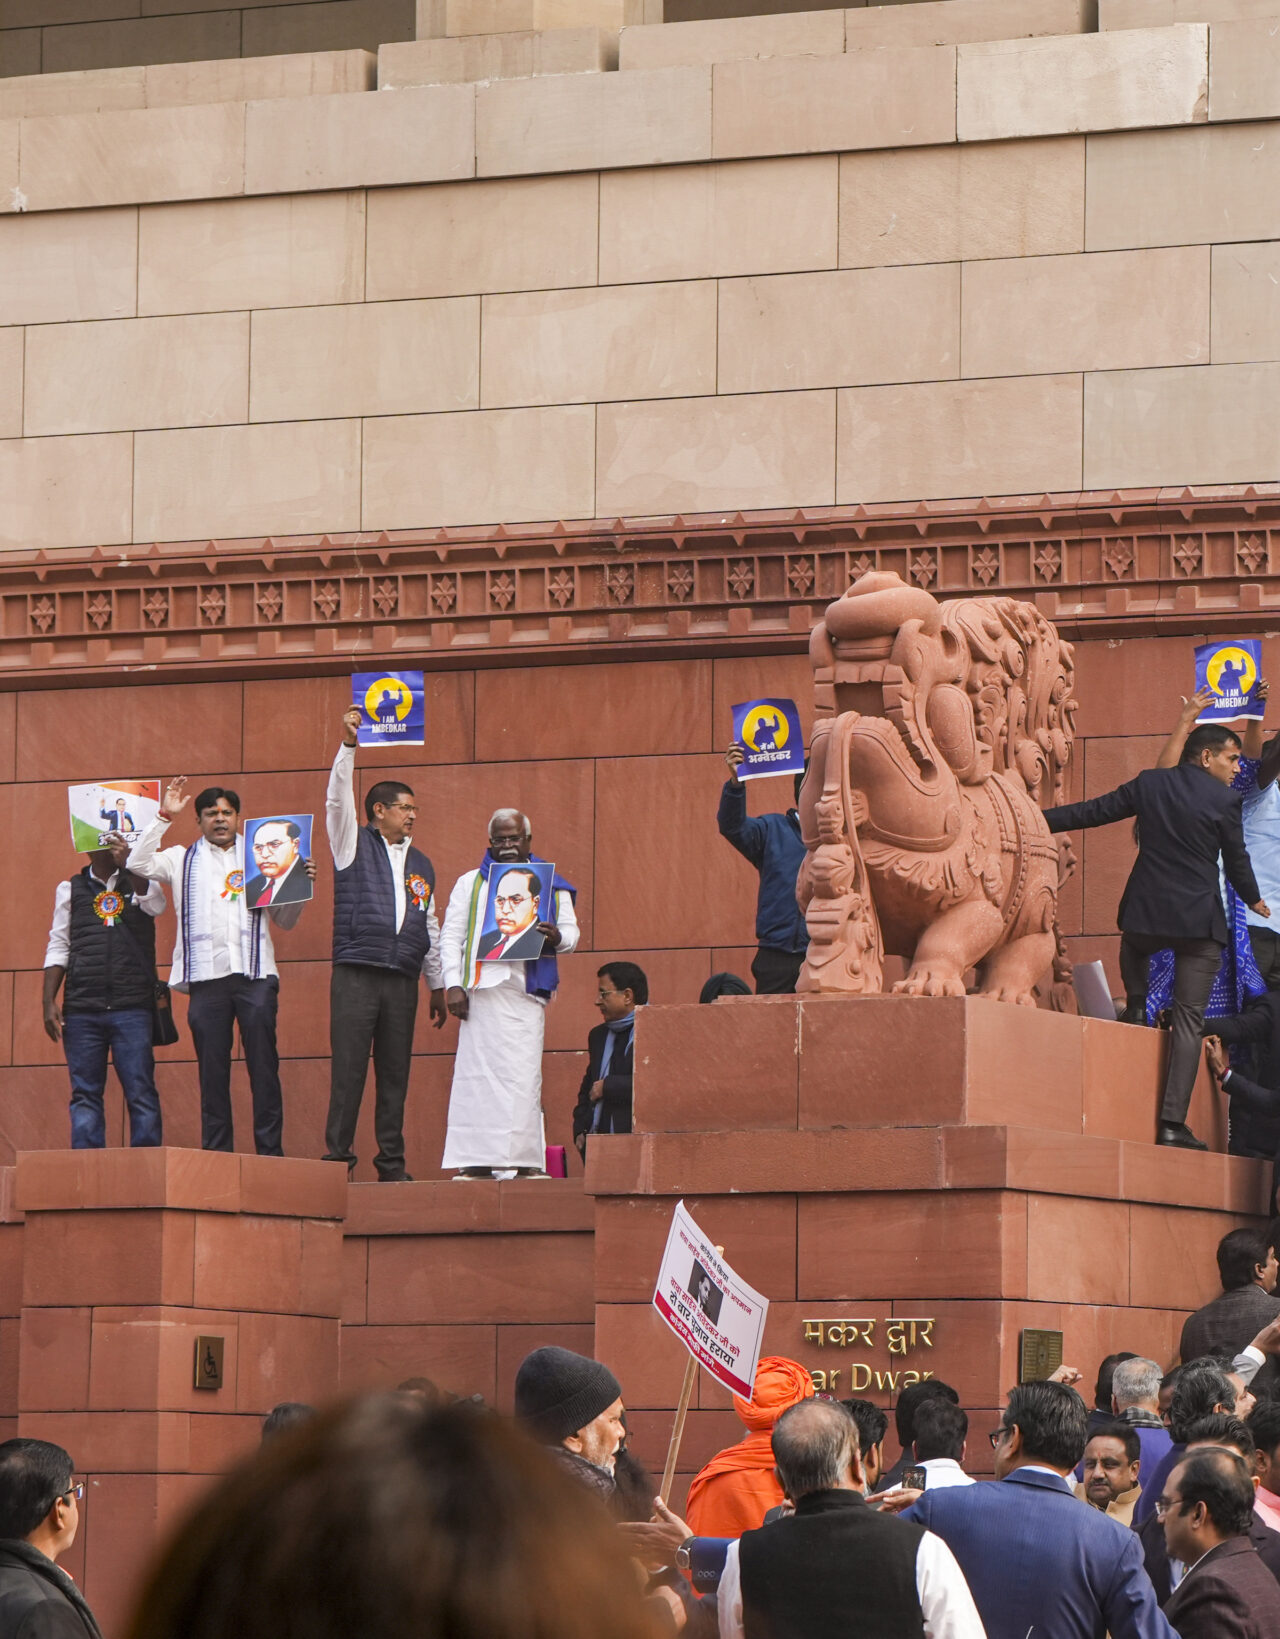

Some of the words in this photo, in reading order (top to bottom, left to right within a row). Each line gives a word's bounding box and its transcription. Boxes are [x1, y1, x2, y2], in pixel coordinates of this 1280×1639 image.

[1227, 689, 1229, 697] I
[372, 723, 406, 733] AMBEDKAR
[669, 1291, 678, 1307] दो
[690, 1316, 709, 1344] चुनाव
[709, 1339, 735, 1369] हराया
[802, 1319, 876, 1346] मकर
[885, 1318, 935, 1355] द्वार
[719, 1334, 729, 1349] जी
[730, 1343, 740, 1358] को
